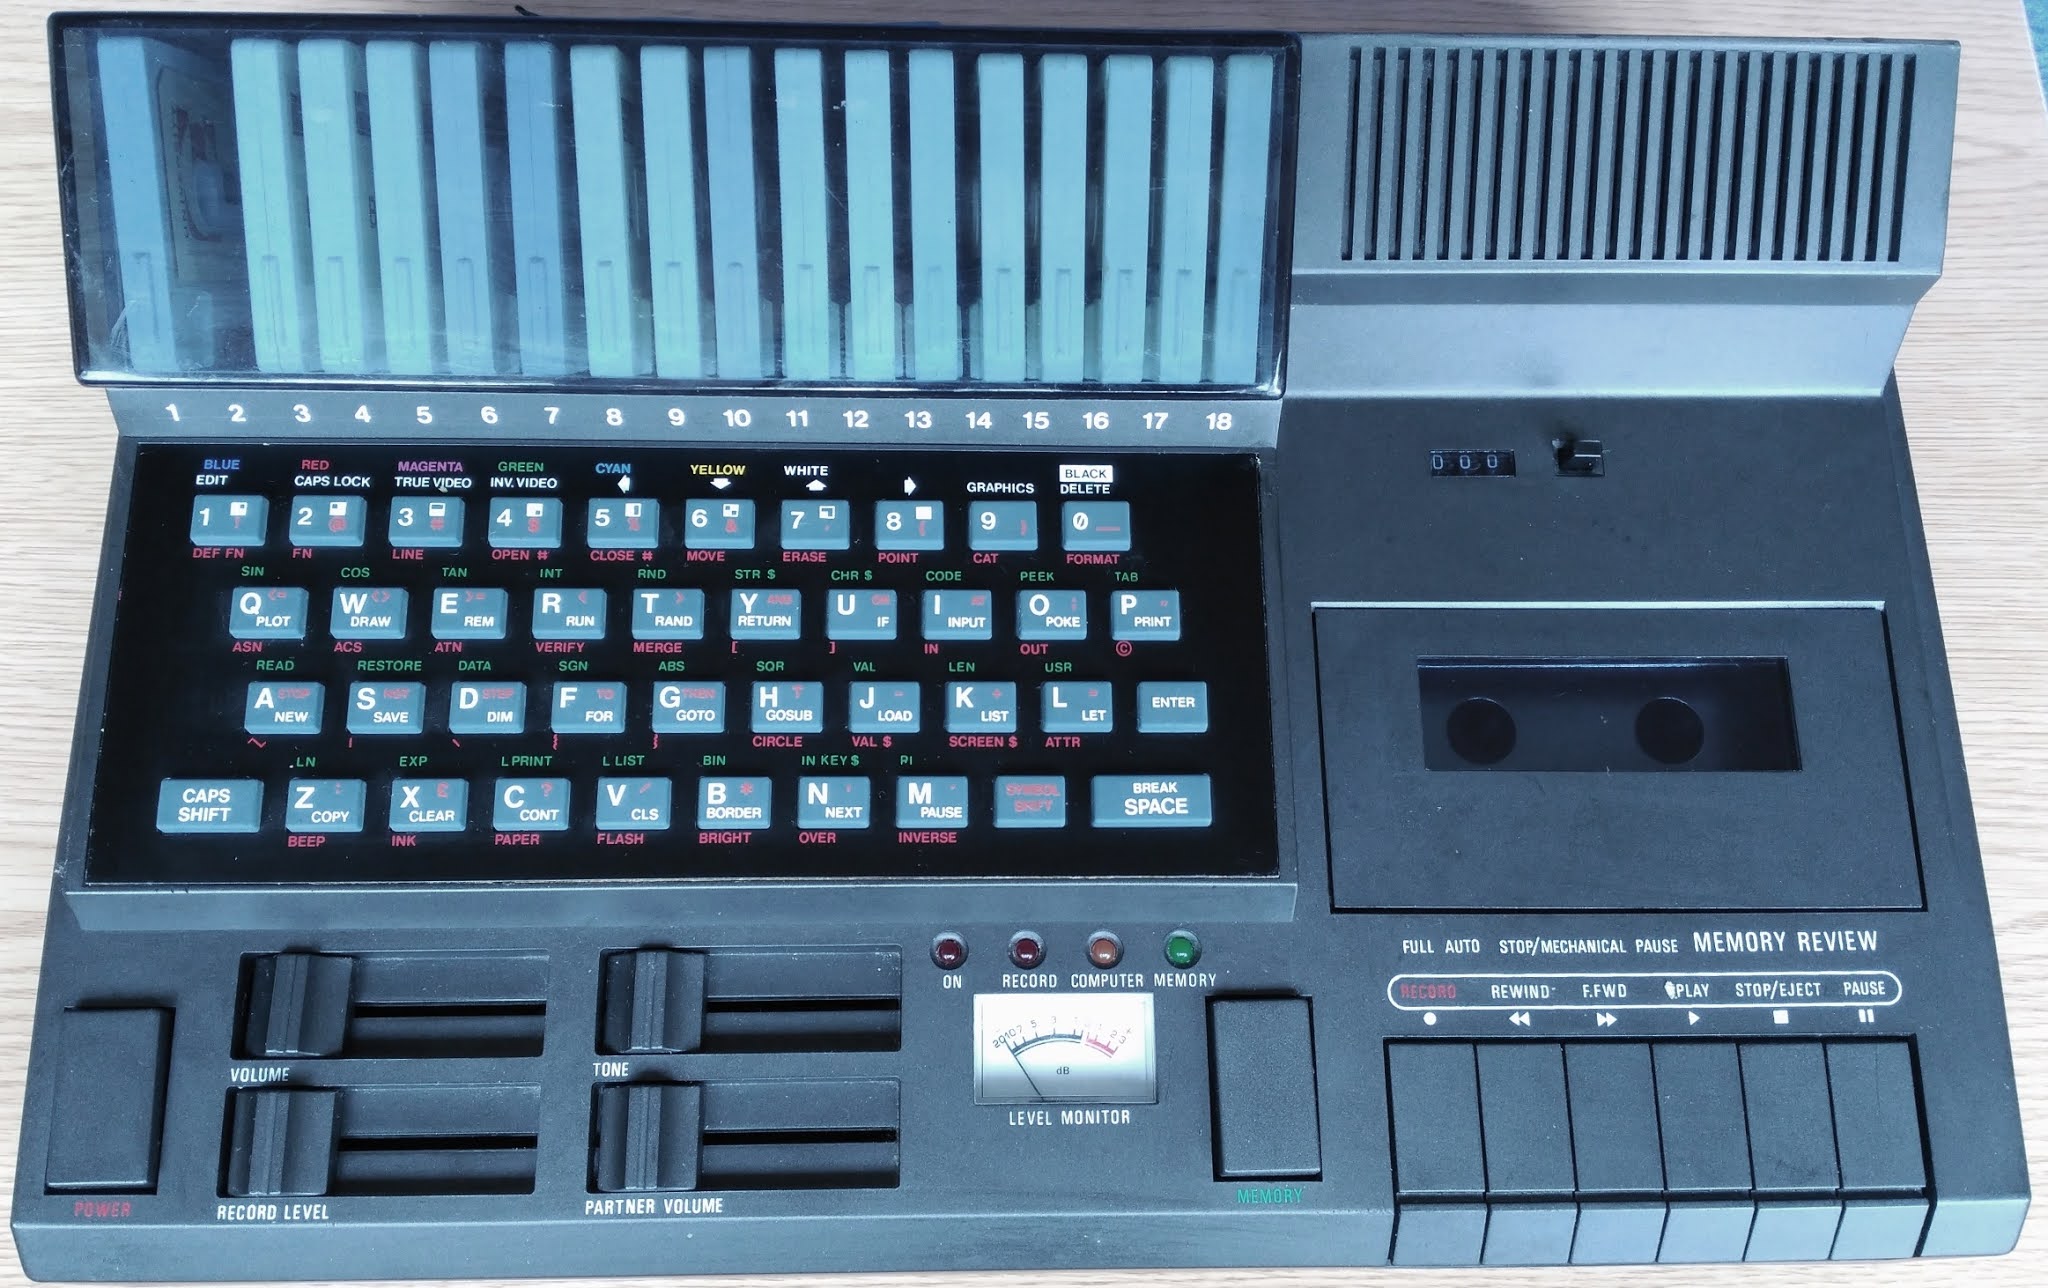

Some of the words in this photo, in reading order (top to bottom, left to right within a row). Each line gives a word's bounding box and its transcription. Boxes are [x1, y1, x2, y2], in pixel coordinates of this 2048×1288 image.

[166, 404, 180, 421] 1
[229, 404, 246, 422] 2
[293, 404, 311, 422] 3
[355, 405, 371, 422] 4
[417, 406, 432, 424] 5
[481, 406, 498, 424] 6
[544, 407, 559, 424] 7
[606, 408, 623, 426] 8
[668, 408, 685, 425] 9
[723, 409, 751, 426] 10
[786, 410, 808, 426] 11
[843, 410, 869, 427] 12
[905, 411, 932, 428] 13
[966, 412, 992, 429] 14
[1023, 412, 1049, 429] 15
[1083, 412, 1109, 429] 16
[1143, 412, 1168, 429] 17
[1206, 413, 1232, 430] 18
[204, 460, 240, 469] BLUE
[302, 460, 329, 470] RED
[398, 461, 463, 472] MAGENTA
[498, 462, 543, 472] GREEN
[596, 463, 631, 473] CYAN
[691, 465, 745, 475] YELLOW
[784, 466, 828, 476] WHITE
[1066, 470, 1106, 478] BLACK
[196, 475, 228, 485] EDIT
[295, 476, 330, 486] CAPS
[334, 476, 370, 487] LOCK
[395, 477, 430, 487] TRUE
[433, 477, 472, 489] VIDEO
[517, 478, 557, 488] VIDEO
[967, 482, 1034, 493] GRAPHICS
[1061, 484, 1110, 494] DELETE
[193, 547, 221, 558] DEF
[225, 548, 244, 559] FN
[293, 548, 312, 558] FN
[393, 549, 423, 559] LINE
[492, 549, 529, 559] OPEN
[591, 550, 634, 560] CLOSE
[687, 550, 725, 561] MOVE
[783, 552, 826, 562] ERASE
[879, 553, 918, 563] POINT
[973, 553, 998, 563] CAT
[1067, 554, 1120, 564] FORMAT
[242, 566, 264, 576] SIN
[341, 568, 369, 577] COS
[442, 568, 467, 577] TAN
[540, 569, 562, 578] INT
[638, 569, 666, 579] RND
[735, 569, 760, 579] STR
[831, 570, 858, 580] CHR
[926, 571, 961, 581] CODE
[1021, 572, 1054, 581] PEEK
[1115, 572, 1138, 581] TAB
[256, 616, 291, 627] PLOT
[351, 616, 391, 626] DRAW
[464, 616, 494, 626] REM
[566, 616, 594, 626] RUN
[655, 616, 692, 626] RAND
[737, 616, 791, 626] RETURN
[878, 617, 889, 627] IF
[948, 617, 986, 627] INPUT
[1046, 616, 1080, 627] POKE
[1135, 617, 1171, 627] PRINT
[233, 641, 262, 652] ASN
[334, 642, 362, 652] ACS
[435, 642, 462, 652] ATN
[536, 642, 584, 652] VERIFY
[634, 642, 682, 653] MERGE
[925, 644, 938, 654] IN
[1020, 644, 1048, 654] OUT
[257, 660, 294, 670] READ
[358, 660, 422, 671] RESTORE
[459, 661, 491, 670] DATA
[559, 661, 587, 671] SGN
[659, 661, 684, 671] ABS
[757, 661, 784, 671] SQR
[853, 662, 875, 671] VAL
[949, 662, 974, 672] LEN
[1045, 662, 1071, 672] USR
[1153, 697, 1195, 708] ENTER
[275, 712, 308, 722] NEW
[374, 712, 408, 723] SAVE
[488, 711, 513, 722] DIM
[586, 711, 613, 722] FOR
[676, 709, 715, 721] GOTO
[766, 710, 812, 721] GOSUB
[878, 710, 912, 721] LOAD
[982, 711, 1009, 722] LIST
[1082, 710, 1106, 721] LET
[753, 736, 802, 747] CIRCLE
[852, 736, 877, 747] VAL
[949, 736, 1004, 747] SCREEN
[1046, 737, 1080, 747] ATTR
[297, 757, 315, 767] LN
[400, 756, 427, 766] EXP
[703, 756, 725, 765] BIN
[1133, 782, 1177, 793] BREAK
[183, 789, 230, 803] CAPS
[826, 806, 862, 818] NEXT
[1125, 798, 1188, 815] SPACE
[178, 807, 231, 822] SHIFT
[312, 811, 349, 823] COPY
[409, 810, 455, 823] CLEAR
[520, 809, 559, 821] CONT
[632, 809, 659, 820] CLS
[707, 807, 761, 818] BORDER
[921, 807, 962, 818] PAUSE
[288, 836, 325, 847] BEEP
[392, 835, 416, 846] INK
[495, 834, 540, 845] PAPER
[597, 833, 643, 844] FLASH
[699, 832, 751, 843] BRIGHT
[799, 832, 836, 843] OVER
[899, 832, 956, 843] INVERSE
[1403, 940, 1434, 953] FULL
[1445, 939, 1480, 953] AUTO
[1499, 937, 1626, 956] STOP/MECHANICAL
[1636, 939, 1678, 953] PAUSE
[1694, 932, 1785, 952] MEMORY
[1797, 931, 1876, 951] REVIEW
[943, 975, 961, 988] ON
[1003, 974, 1057, 988] RECORD
[1071, 974, 1143, 988] COMPUTER
[1154, 973, 1216, 987] MEMORY
[1401, 984, 1456, 1000] RECORD
[1492, 985, 1549, 998] REWIND
[1583, 984, 1626, 997] F.FWD
[1676, 984, 1709, 997] PLAY
[1736, 980, 1820, 999] STOP/EJECT
[1844, 981, 1885, 995] PAUSE
[230, 1066, 289, 1083] VOLUME
[593, 1062, 629, 1077] TONE
[1057, 1067, 1069, 1075] dB
[1010, 1111, 1052, 1125] LEVEL
[1062, 1110, 1129, 1124] MONITOR
[1237, 1188, 1303, 1204] MEMORY
[75, 1201, 131, 1217] POWER
[217, 1204, 277, 1220] RECORD
[284, 1204, 328, 1219] LEVEL
[586, 1199, 655, 1215] PARTNER
[664, 1198, 723, 1214] VOLUME
